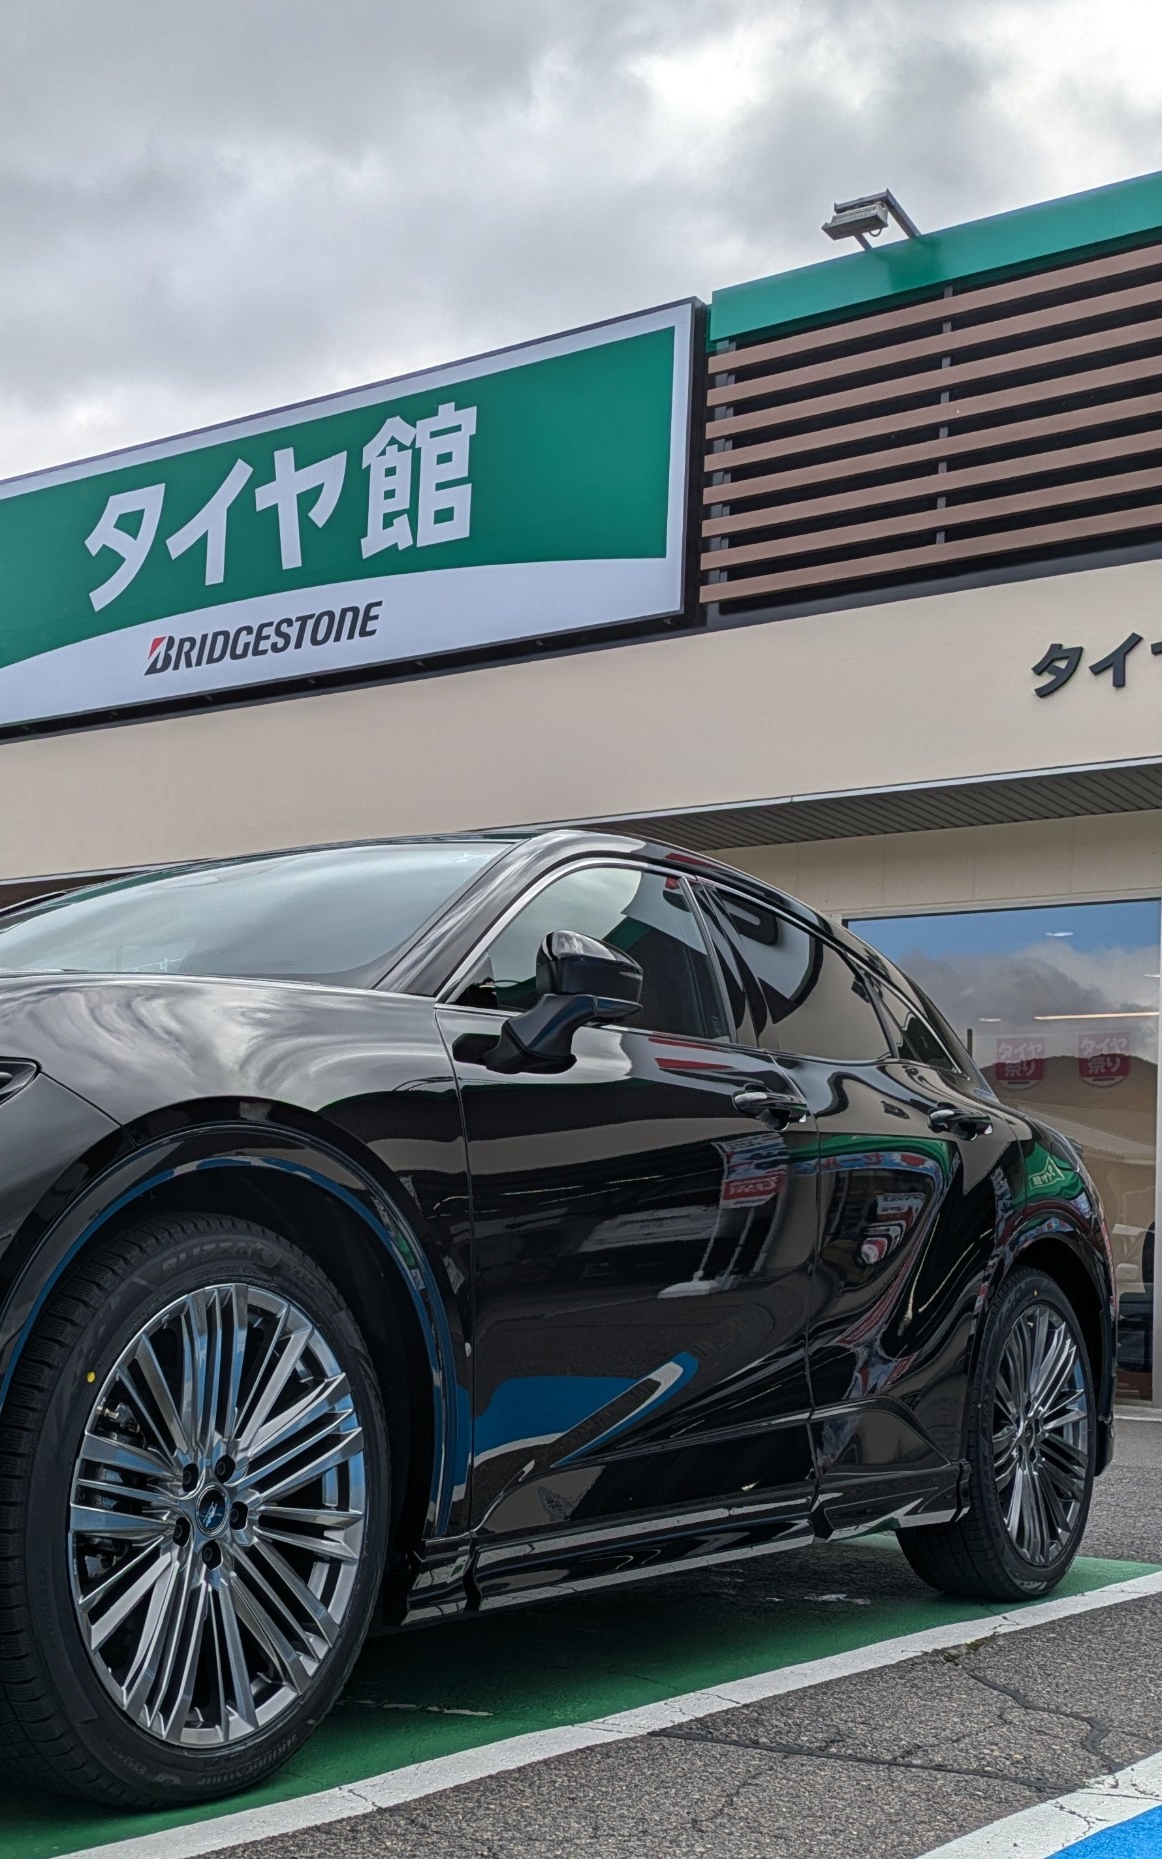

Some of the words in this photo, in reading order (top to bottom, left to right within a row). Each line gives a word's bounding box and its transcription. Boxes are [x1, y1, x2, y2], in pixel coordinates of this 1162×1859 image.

[84, 401, 478, 613] タイヤ館
[144, 600, 384, 676] BRIDGESTONE
[1031, 632, 1162, 698] タイ
[998, 1042, 1043, 1059] タイヤ
[1080, 1037, 1128, 1056] タイヤ
